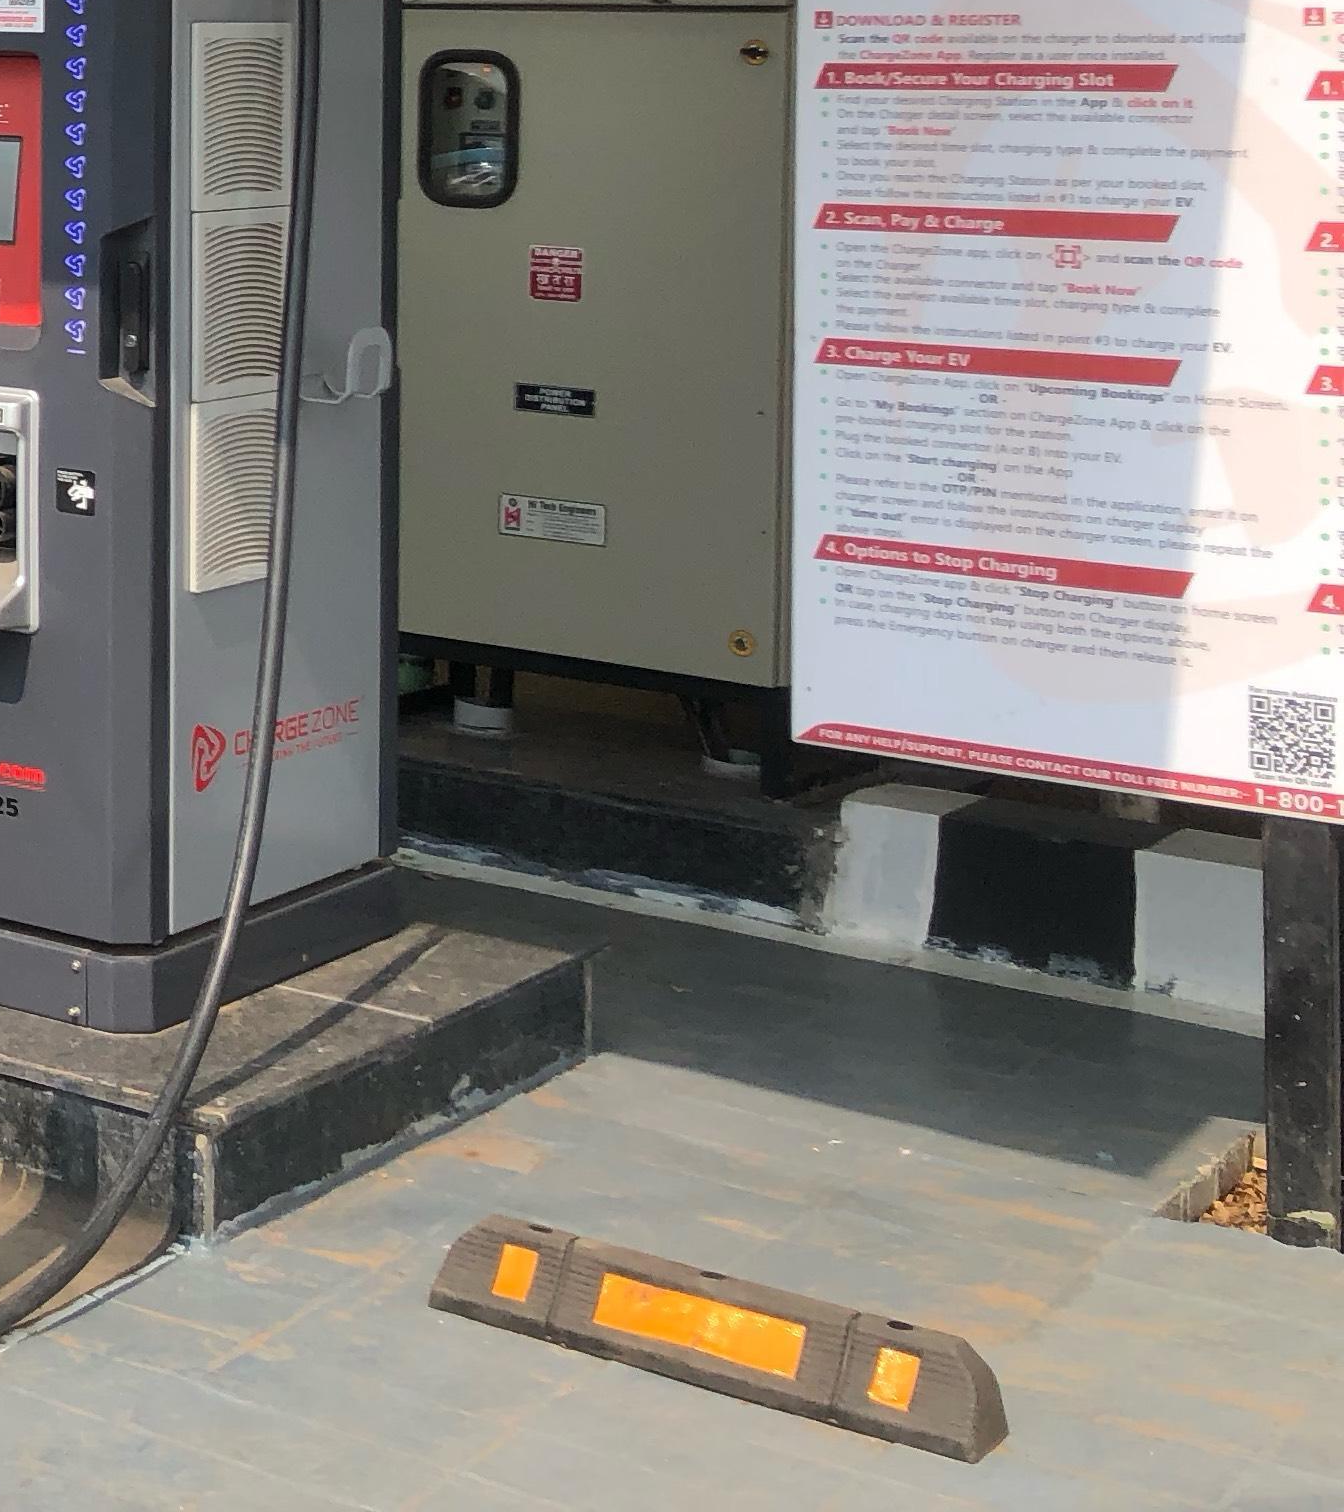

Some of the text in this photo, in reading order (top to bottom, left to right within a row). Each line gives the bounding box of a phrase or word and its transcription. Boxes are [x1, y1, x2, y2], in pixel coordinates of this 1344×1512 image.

[836, 15, 926, 27] DOWNLOAD
[948, 14, 1021, 26] REGISTER
[826, 72, 1114, 89] 1. Book/Secure Your Charging Slot
[825, 211, 1005, 233] 2. Scan, Pay & Charge
[826, 345, 972, 367] 3. Charge Your EV
[824, 540, 1058, 581] 4. Options to Stop Charging
[818, 728, 843, 740] FOR
[845, 732, 870, 744] ANY
[969, 751, 1013, 766] PLEASE
[1016, 757, 1080, 775] CONTACT
[1082, 767, 1113, 781] OUR
[1115, 771, 1145, 785] TOLL
[1147, 776, 1178, 789] FREE
